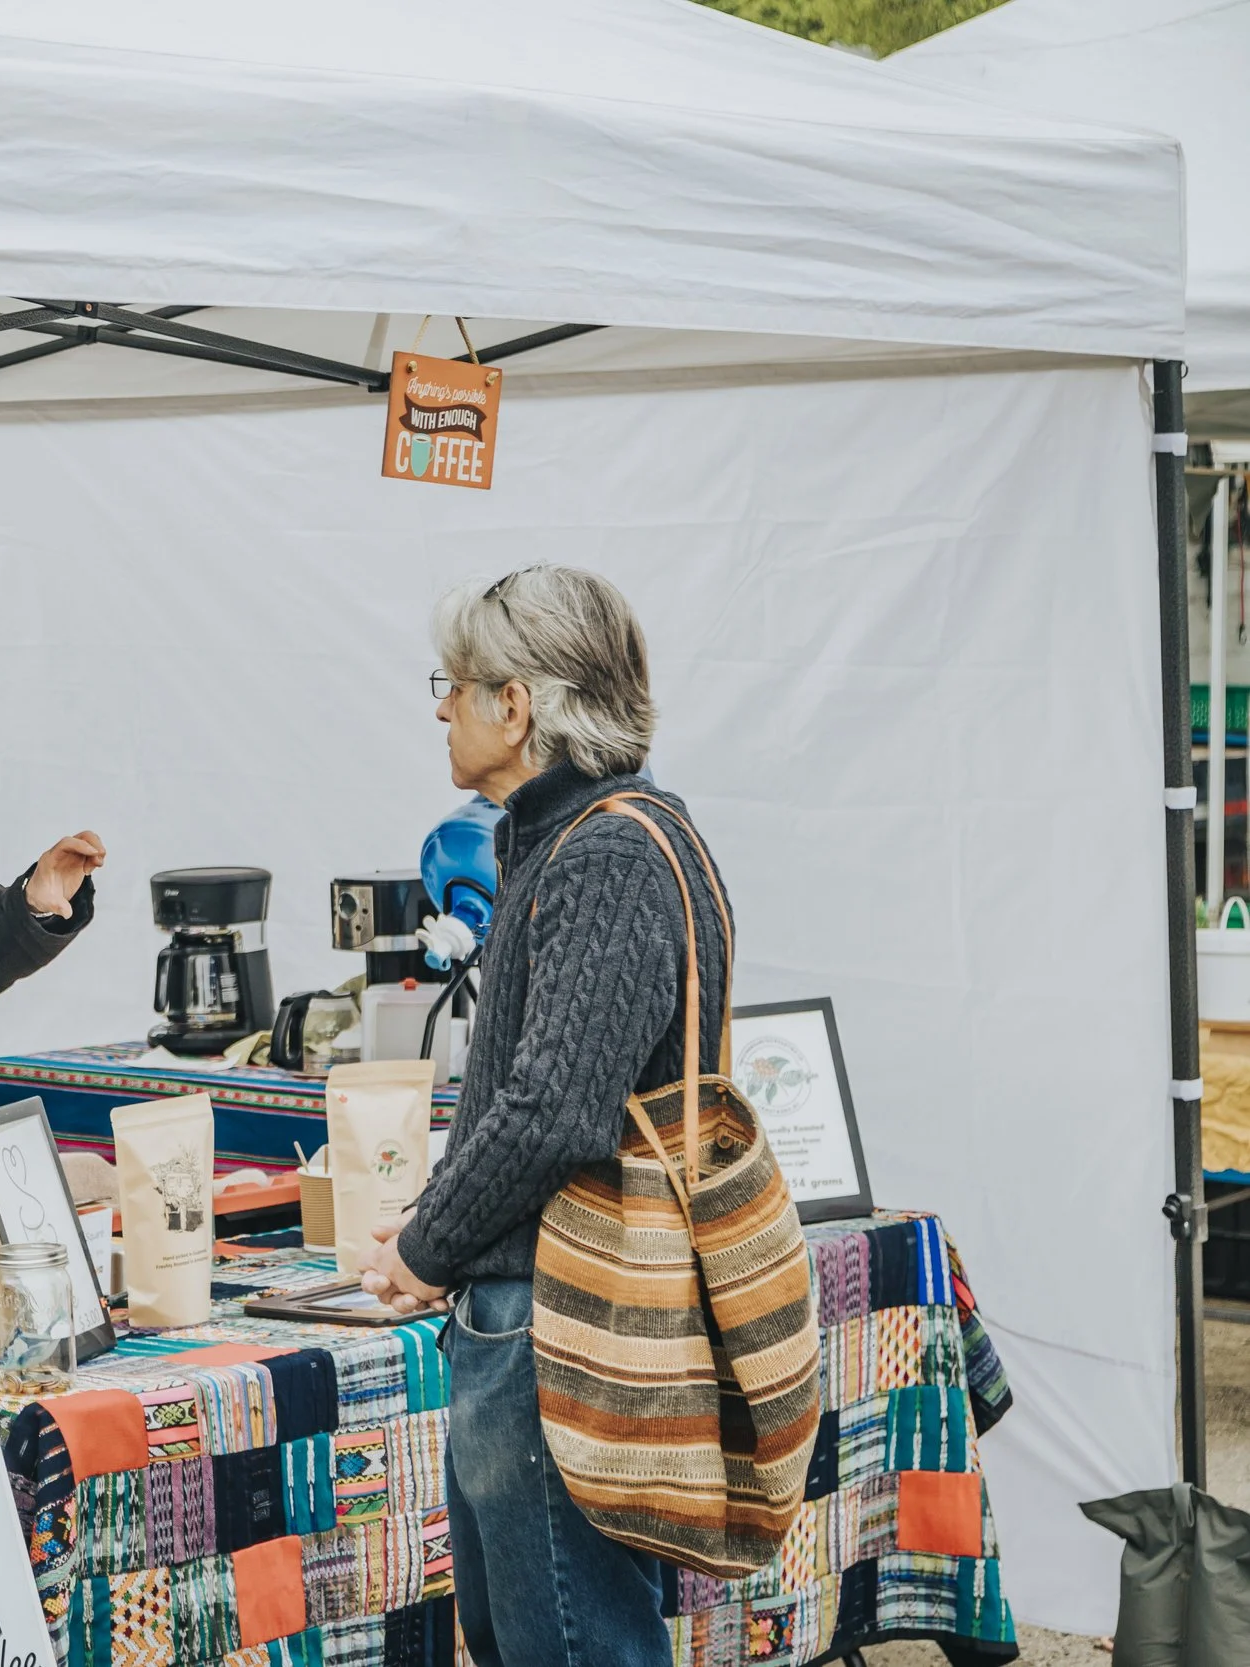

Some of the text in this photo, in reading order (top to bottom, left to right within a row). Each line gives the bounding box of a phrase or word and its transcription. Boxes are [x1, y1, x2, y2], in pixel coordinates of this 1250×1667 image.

[407, 376, 487, 405] Anything's possible
[411, 407, 477, 431] WITH ENOUGH
